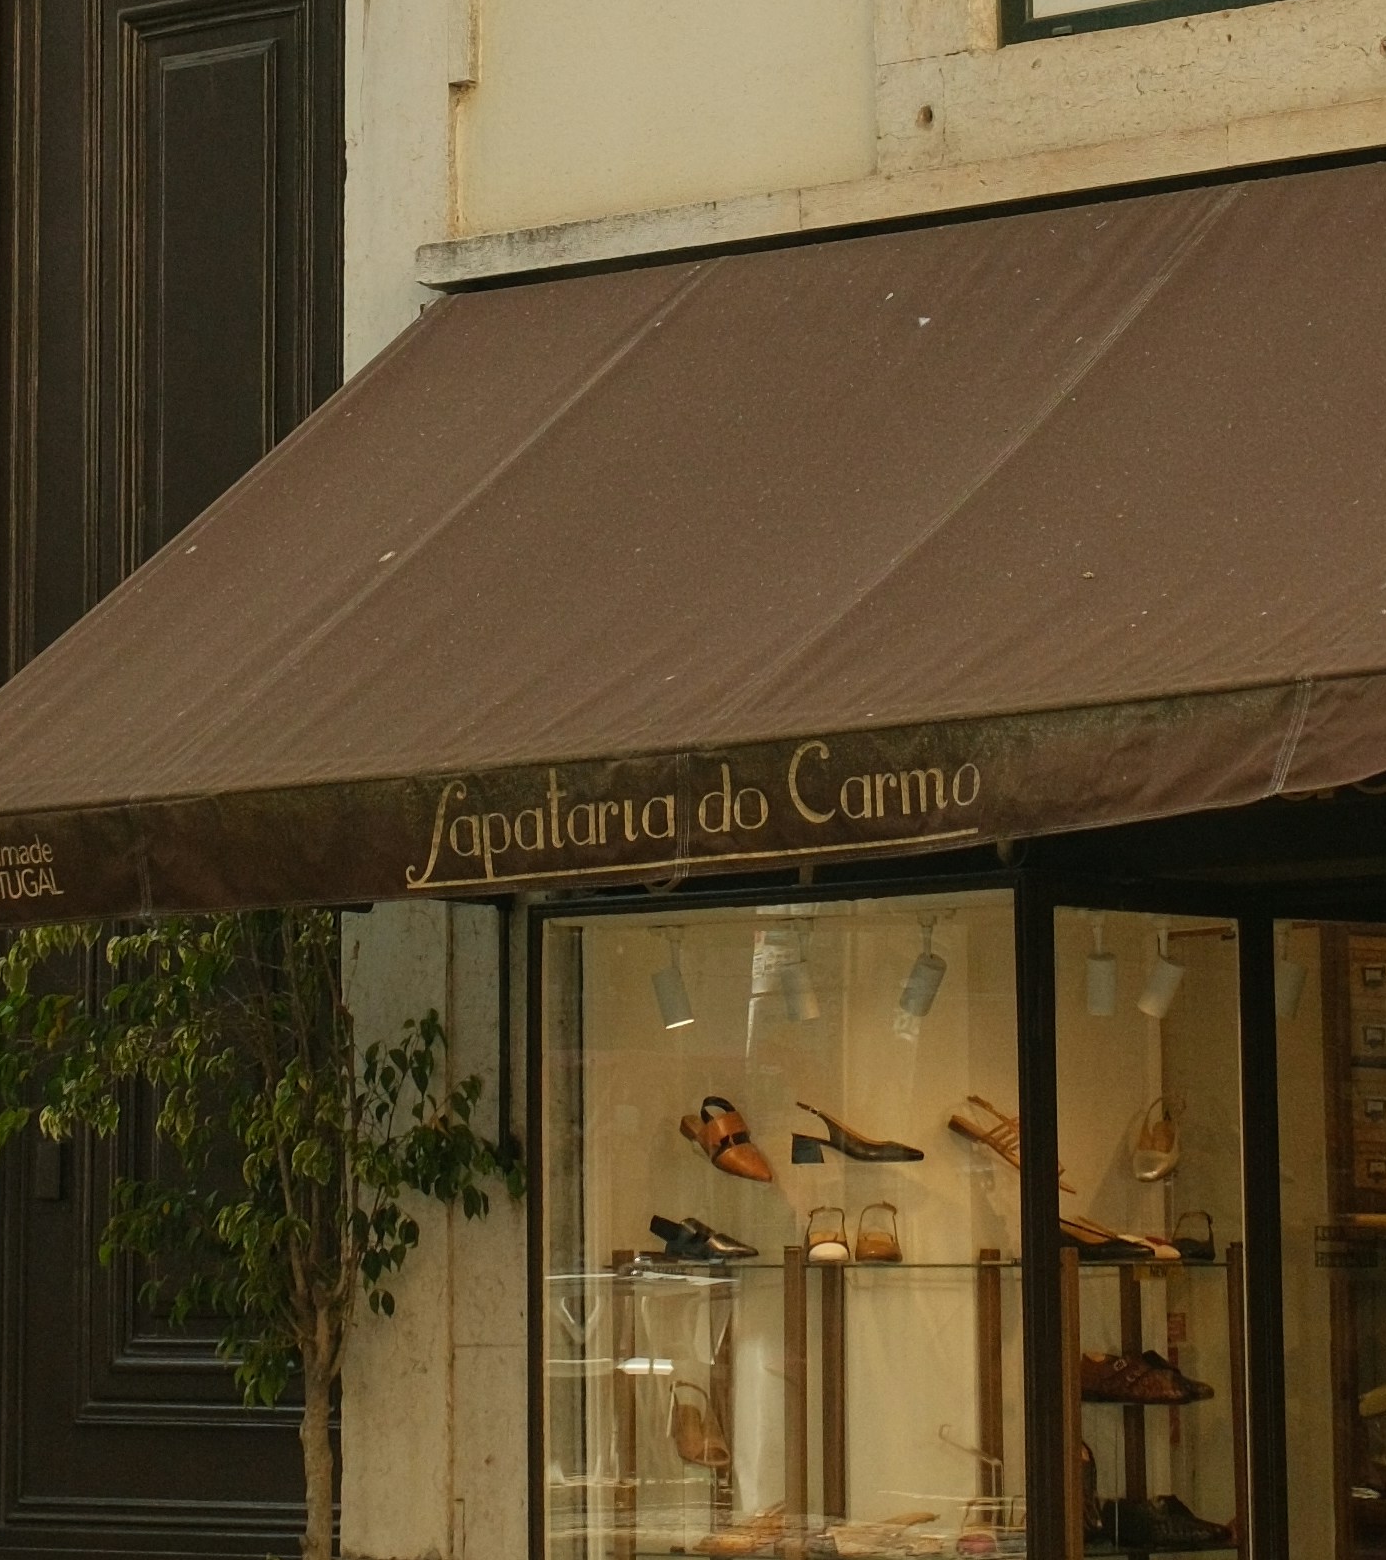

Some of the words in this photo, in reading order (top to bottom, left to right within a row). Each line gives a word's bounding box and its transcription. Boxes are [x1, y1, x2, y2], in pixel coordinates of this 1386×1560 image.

[406, 767, 676, 886] Sapataria
[698, 762, 769, 833] do
[787, 739, 981, 824] Carmo
